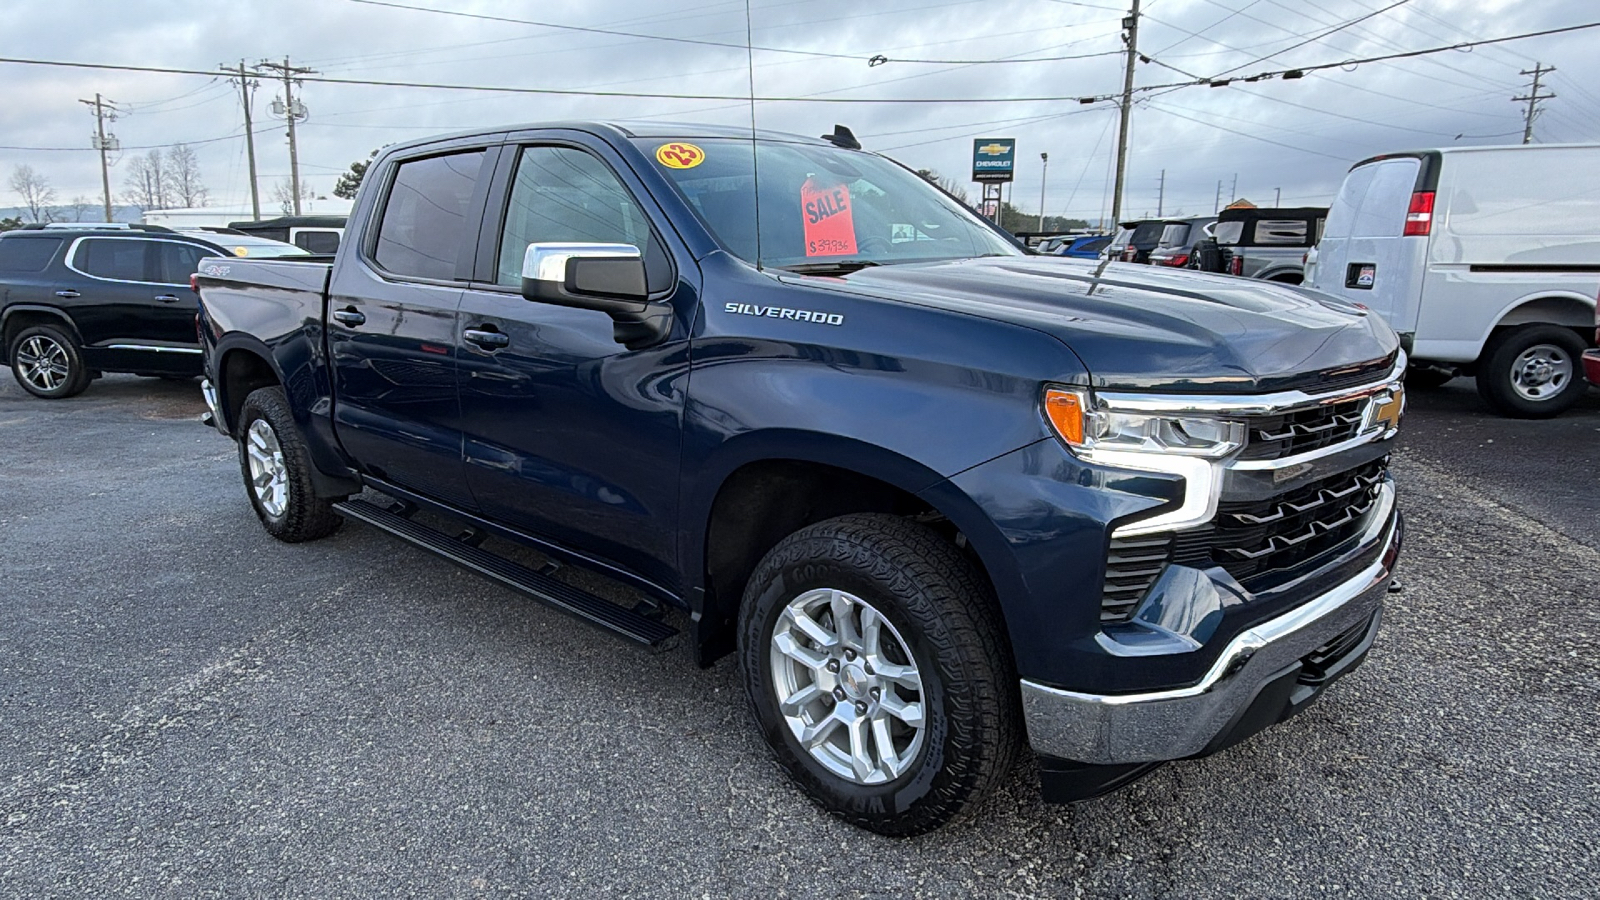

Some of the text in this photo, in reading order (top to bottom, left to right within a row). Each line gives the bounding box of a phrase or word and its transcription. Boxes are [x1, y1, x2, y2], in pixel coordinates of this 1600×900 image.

[664, 144, 697, 166] 23
[806, 190, 847, 224] SALE
[724, 302, 844, 326] SILVERADO
